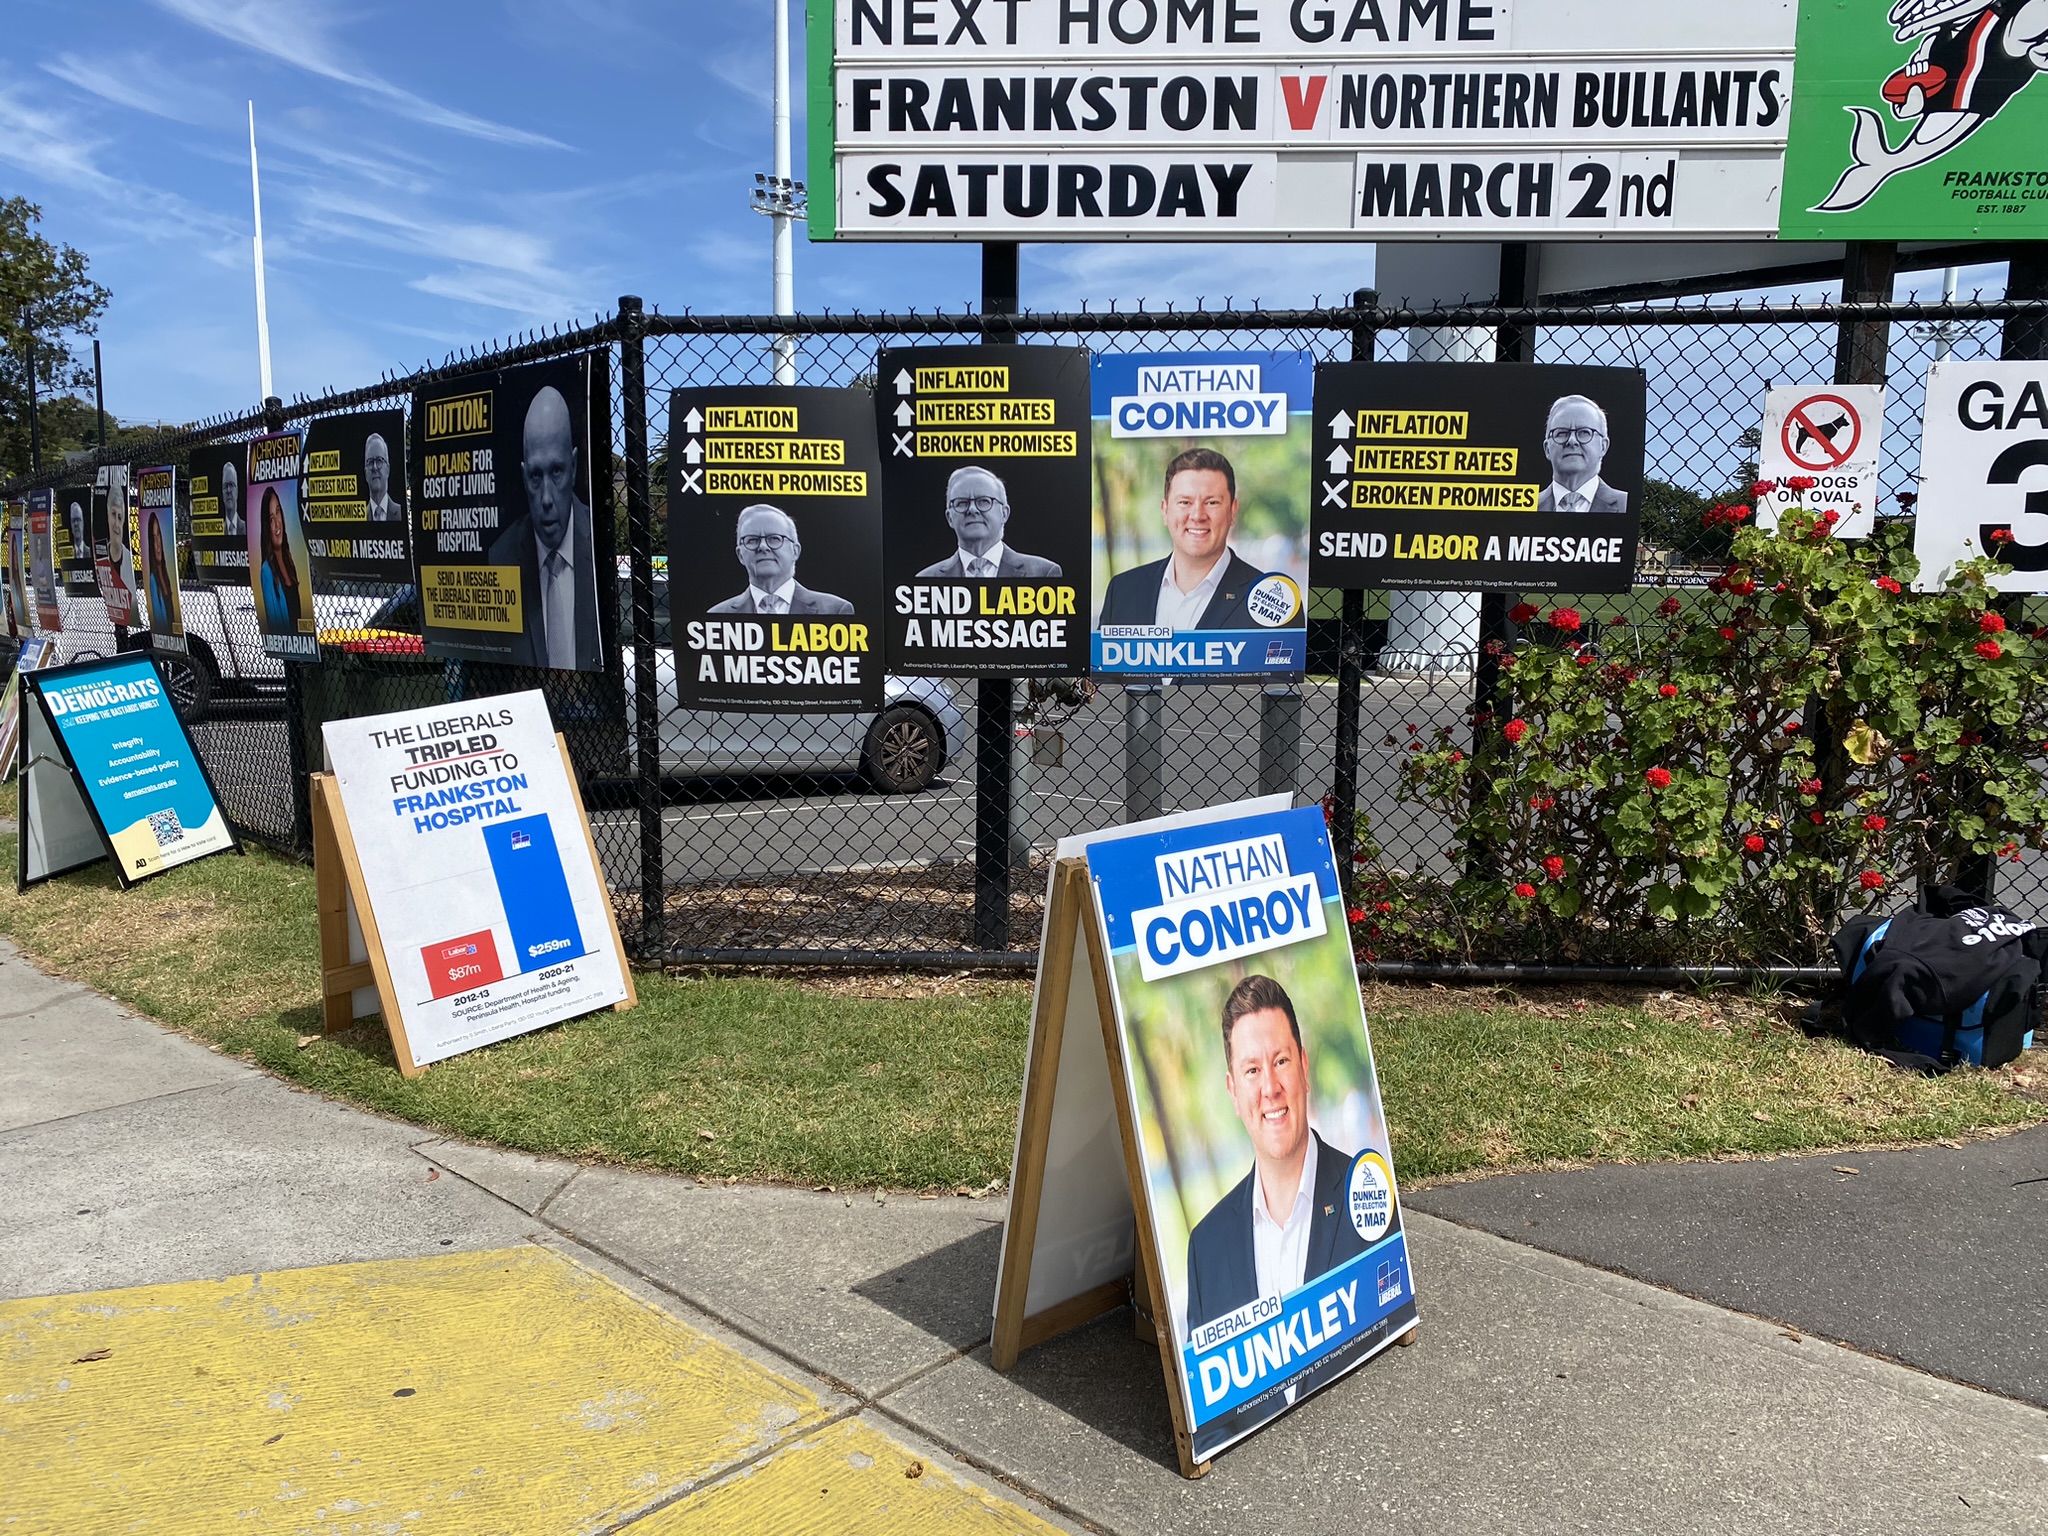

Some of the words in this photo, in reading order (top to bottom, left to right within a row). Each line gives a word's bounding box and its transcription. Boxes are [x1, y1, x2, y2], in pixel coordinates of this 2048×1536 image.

[852, 0, 1018, 46] NEXT
[1059, 0, 1261, 45] HOME
[1290, 0, 1495, 43] GAME
[852, 76, 1258, 132] FRANKSTON
[1280, 75, 1328, 131] V
[1341, 72, 1559, 129] NORTHERN
[1573, 69, 1780, 128] BULLANTS
[867, 163, 1253, 218] SATURDAY
[1360, 162, 1554, 219] MARCH
[1951, 189, 2017, 200] FOOTBALL
[2021, 189, 2048, 200] CLU
[1976, 204, 1999, 213] EST.
[2002, 204, 2027, 213] 1887
[919, 370, 1005, 389] INFLATION
[1143, 369, 1254, 393] NATHAN
[429, 397, 488, 436] DUTTON:
[709, 410, 794, 428] INFLATION
[919, 403, 995, 421] INTEREST
[1000, 403, 1051, 421] RATES
[1118, 400, 1280, 431] CONROY
[1360, 414, 1464, 435] INFLATION
[256, 436, 300, 460] CHRYSTEN
[709, 442, 785, 460] INTEREST
[790, 443, 841, 461] RATES
[920, 435, 984, 453] BROKEN
[989, 435, 1073, 453] PROMISES
[254, 454, 300, 482] ABRAHAM
[425, 455, 438, 476] NO
[440, 451, 470, 475] PLANS
[472, 449, 493, 472] FOR
[1358, 450, 1450, 471] INTEREST
[1454, 451, 1513, 472] RATES
[309, 479, 336, 494] INTEREST
[336, 478, 356, 493] RATES
[423, 476, 446, 499] COST
[448, 475, 460, 497] OF
[462, 473, 495, 496] LIVING
[709, 473, 774, 491] BROKEN
[779, 474, 863, 492] PROMISES
[1356, 484, 1435, 505] BROKEN
[1439, 486, 1535, 508] PROMISES
[1777, 490, 1801, 503] ON
[1810, 490, 1855, 503] OVAL
[311, 504, 333, 519] BROKEN
[334, 503, 366, 519] PROMISES
[422, 509, 439, 531] CUT
[440, 506, 499, 530] FRANKSTON
[326, 539, 351, 558] LABOR
[352, 540, 358, 558] A
[360, 539, 405, 559] MESSAGE
[437, 530, 482, 553] HOSPITAL
[1319, 531, 1387, 559] SEND
[1393, 533, 1480, 561] LABOR
[1483, 536, 1501, 561] A
[1507, 536, 1623, 563] MESSAGE
[437, 571, 454, 587] SEND
[456, 571, 462, 586] A
[463, 571, 500, 587] MESSAGE.
[426, 586, 438, 602] THE
[439, 587, 470, 603] LIBERALS
[472, 588, 491, 605] NEED
[493, 589, 503, 605] TO
[505, 590, 516, 606] DO
[895, 585, 972, 615] SEND
[979, 586, 1076, 616] LABOR
[1255, 588, 1291, 610] DUNKLEY
[433, 604, 456, 620] BETTER
[457, 605, 476, 621] THAN
[478, 606, 510, 623] DUTTON.
[1250, 602, 1258, 611] 2
[1258, 606, 1282, 624] MAR
[686, 620, 764, 650] SEND
[771, 623, 869, 652] LABOR
[904, 618, 925, 647] A
[931, 619, 1067, 648] MESSAGE
[1103, 627, 1146, 637] LIBERAL
[1148, 627, 1170, 637] FOR
[263, 633, 316, 655] LIBERTARIAN
[1102, 641, 1247, 666] DUNKLEY
[698, 654, 718, 683] A
[723, 655, 861, 684] MESSAGE
[1264, 656, 1292, 665] LIBERAL
[43, 678, 160, 717] DEMOCRATS
[61, 680, 112, 695] AUSTRALIAN
[74, 712, 101, 725] KEEPING
[99, 709, 111, 720] THE
[368, 726, 415, 749] THE
[416, 709, 514, 741] LIBERALS
[111, 737, 144, 750] Integrity
[404, 733, 498, 765] TRIPLED
[108, 748, 160, 768] Accountability
[98, 764, 158, 787] Evidence-based
[157, 759, 179, 773] policy
[390, 759, 488, 793] FUNDING
[489, 753, 518, 772] TO
[393, 773, 529, 816] FRANKSTON
[413, 797, 522, 834] HOSPITAL
[1163, 841, 1284, 898] NATHAN
[1145, 883, 1312, 966] CONROY
[528, 937, 572, 958] $259m
[448, 964, 482, 981] $87m
[538, 964, 575, 981] 2020-21
[451, 1003, 484, 1019] SOURCE:
[484, 992, 522, 1009] Department
[523, 989, 530, 997] of
[530, 984, 551, 995] Health
[551, 981, 557, 989] &
[453, 989, 490, 1007] 2012-13
[466, 1008, 499, 1023] Peninsula
[499, 1001, 522, 1014] Health,
[521, 993, 547, 1007] Hospital
[547, 986, 571, 999] funding
[1352, 1189, 1387, 1202] DUNKLEY
[1356, 1213, 1362, 1228] 2
[1364, 1212, 1386, 1228] MAR
[1379, 1283, 1402, 1308] LIBERAL
[1195, 1312, 1253, 1351] LIBERAL
[1251, 1296, 1279, 1324] FOR
[1198, 1278, 1359, 1407] DUNKLEY
